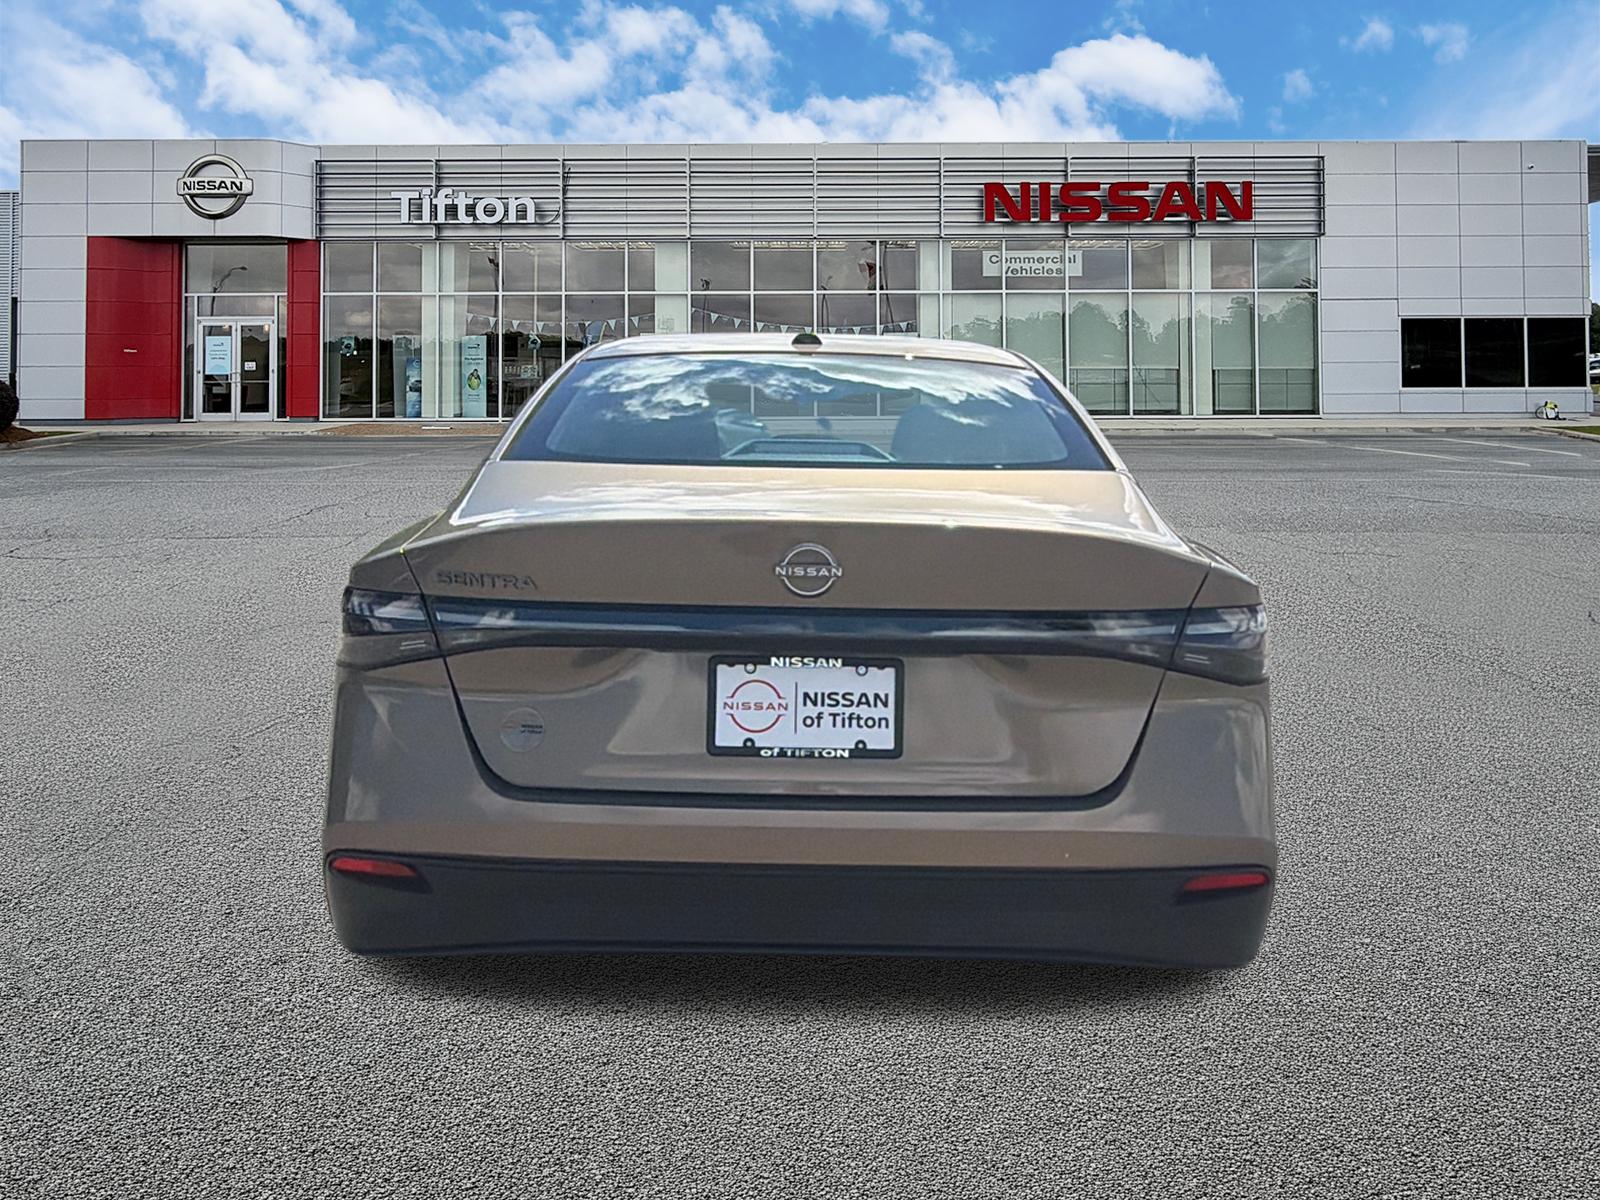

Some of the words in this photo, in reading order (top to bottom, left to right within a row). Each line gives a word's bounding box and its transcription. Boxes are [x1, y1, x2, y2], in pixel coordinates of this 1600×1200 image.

[182, 180, 243, 192] NISSAN
[391, 187, 536, 224] Tifton
[983, 181, 1254, 222] NISSAN
[775, 566, 843, 577] NISSAN
[437, 570, 538, 590] SENTRA
[770, 656, 843, 669] NISSAN
[722, 701, 789, 712] NISSAN
[802, 691, 890, 709] NISSAN
[802, 712, 824, 729] of
[829, 712, 890, 730] Tifton
[759, 747, 780, 758] of
[784, 748, 850, 758] TIFTON
